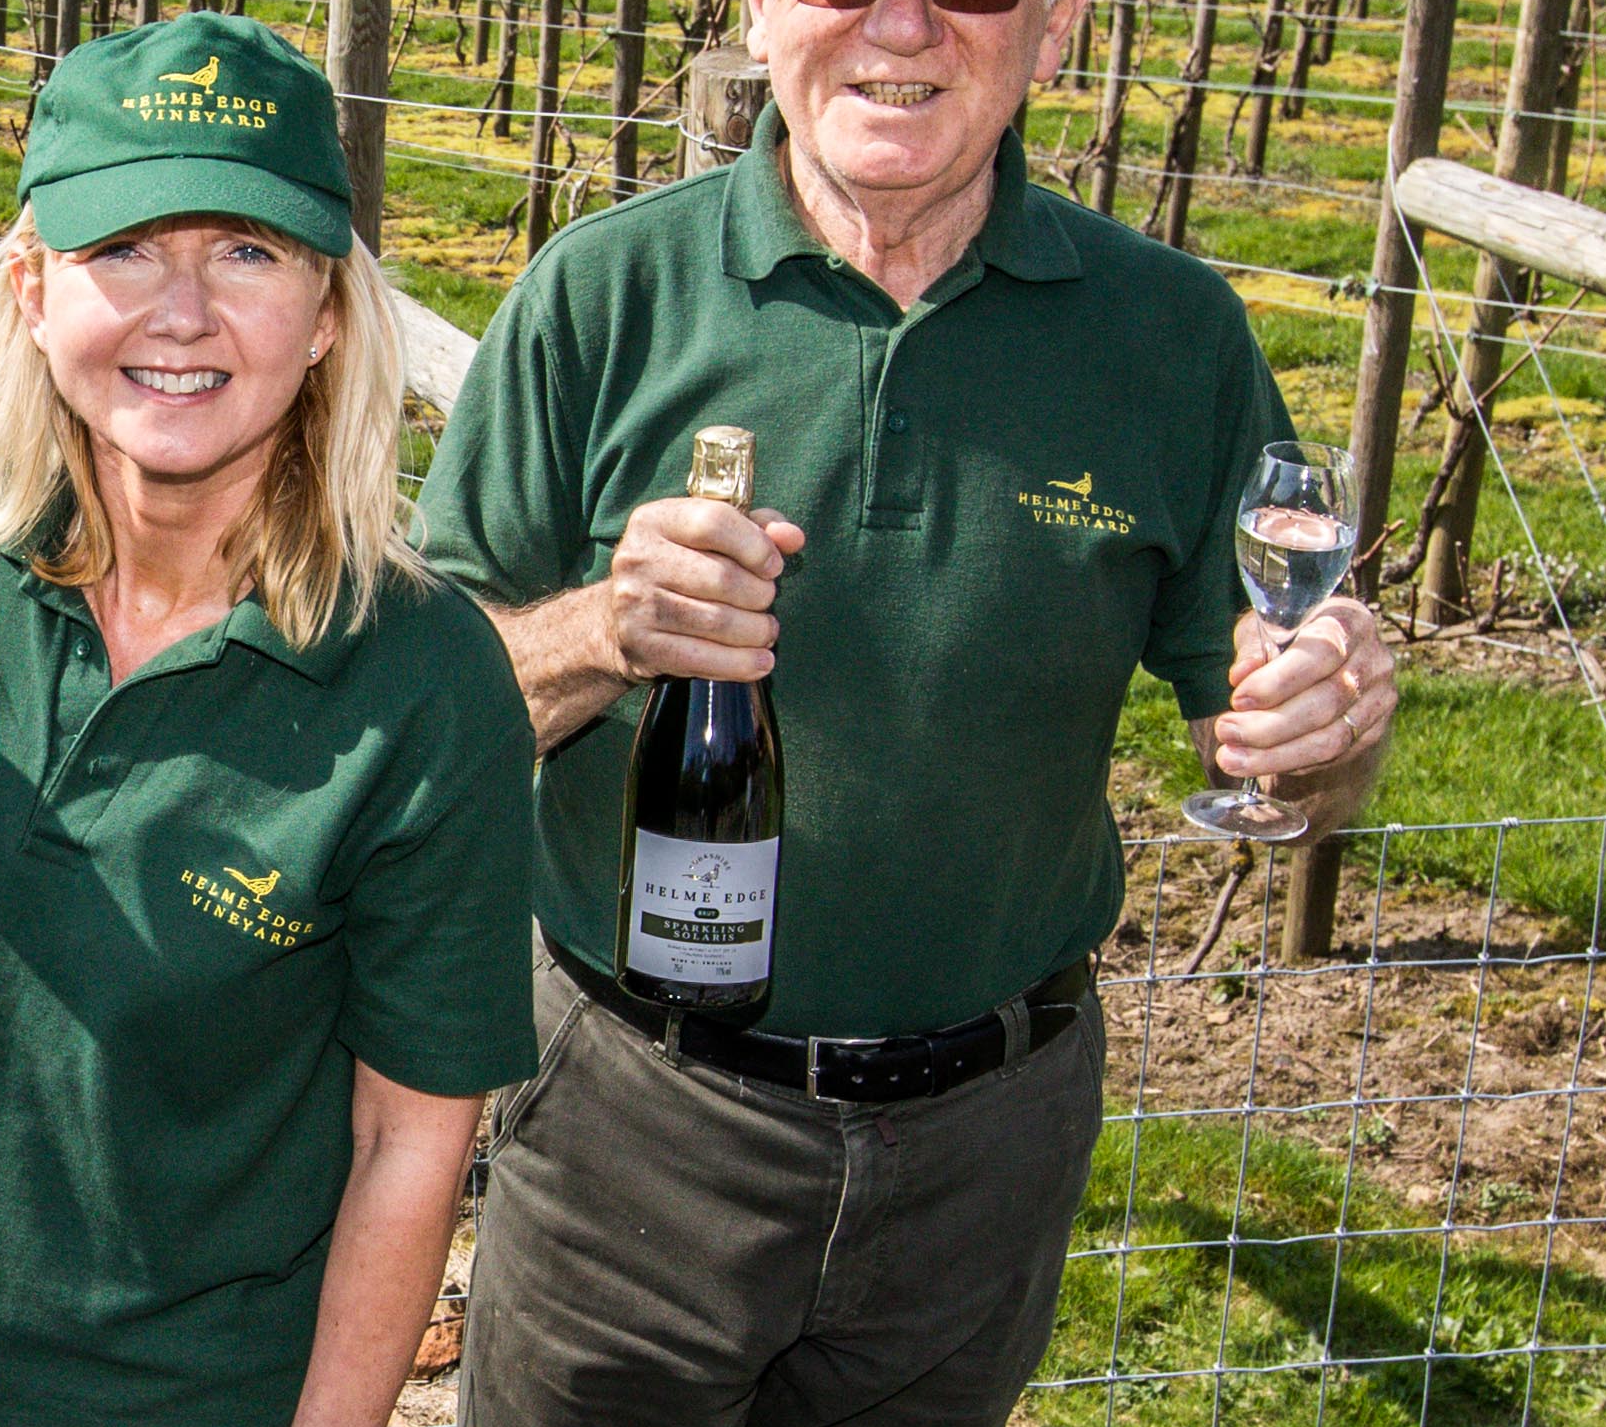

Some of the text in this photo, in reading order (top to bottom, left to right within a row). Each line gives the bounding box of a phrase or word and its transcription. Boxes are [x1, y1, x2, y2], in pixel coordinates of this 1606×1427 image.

[122, 91, 278, 115] HELME EDGE
[140, 109, 267, 129] VINEYARD
[1018, 491, 1082, 512] HELME
[1033, 510, 1130, 535] VINEYARD
[180, 869, 314, 934] HELME EDGE
[645, 882, 766, 904] HELME EDGE
[191, 893, 296, 947] VINEYARD
[663, 920, 745, 934] SPARKLING
[673, 930, 735, 942] SOLARIS
